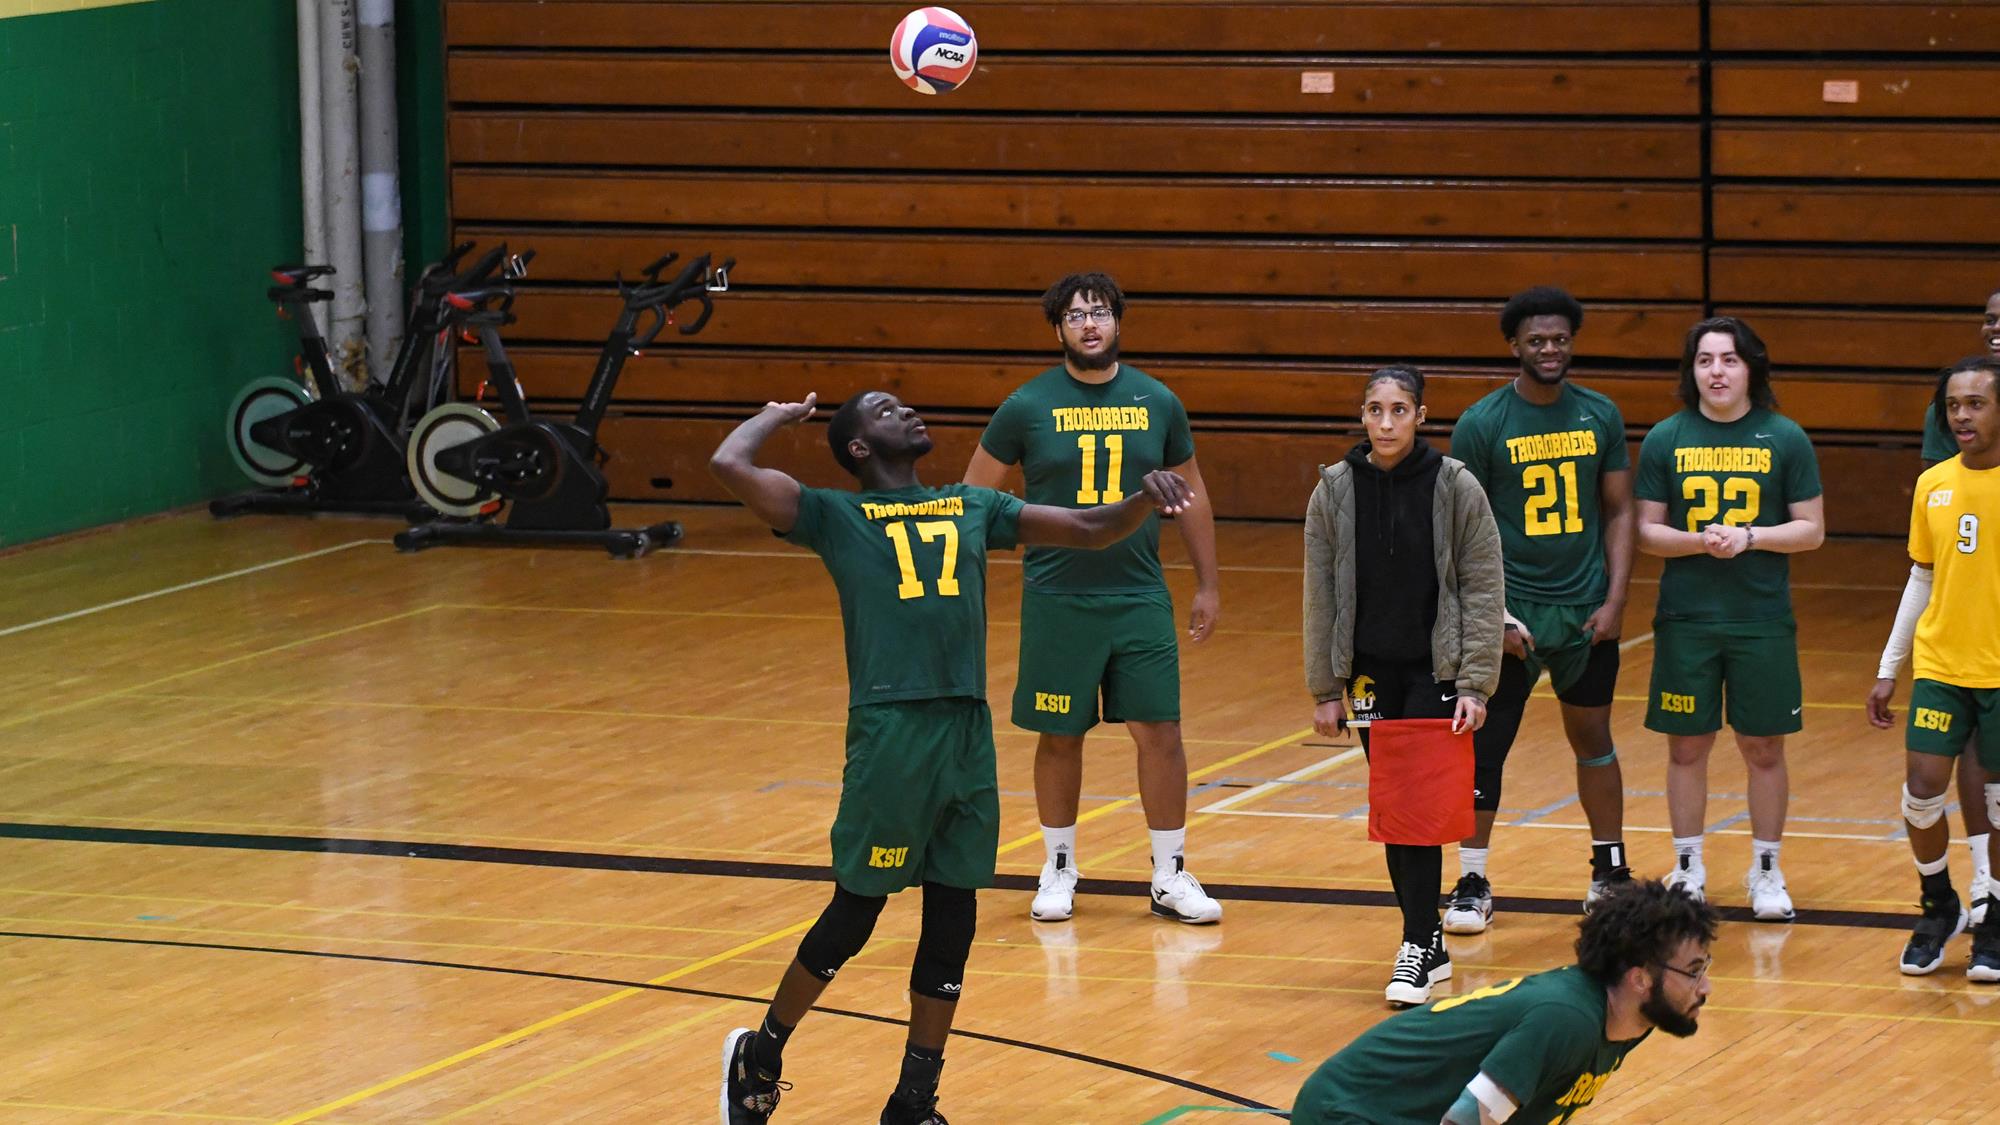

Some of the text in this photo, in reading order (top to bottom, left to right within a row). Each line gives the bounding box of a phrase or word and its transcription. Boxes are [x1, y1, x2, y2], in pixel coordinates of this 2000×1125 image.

[935, 47, 965, 63] NCAA
[1052, 407, 1149, 432] THOROBREDS
[1506, 430, 1597, 464] THOROBREDS
[1077, 434, 1123, 504] 11
[1674, 447, 1771, 473] THOROBREDS
[1522, 461, 1583, 536] 21
[1682, 476, 1760, 533] 22
[1957, 513, 1979, 554] 9
[885, 520, 960, 600] 17
[1035, 692, 1071, 714] KSU
[1350, 697, 1374, 711] SU
[1661, 691, 1695, 713] KSU
[1355, 712, 1384, 721] EYBALL
[1914, 707, 1952, 732] KSU
[869, 846, 909, 868] KSU
